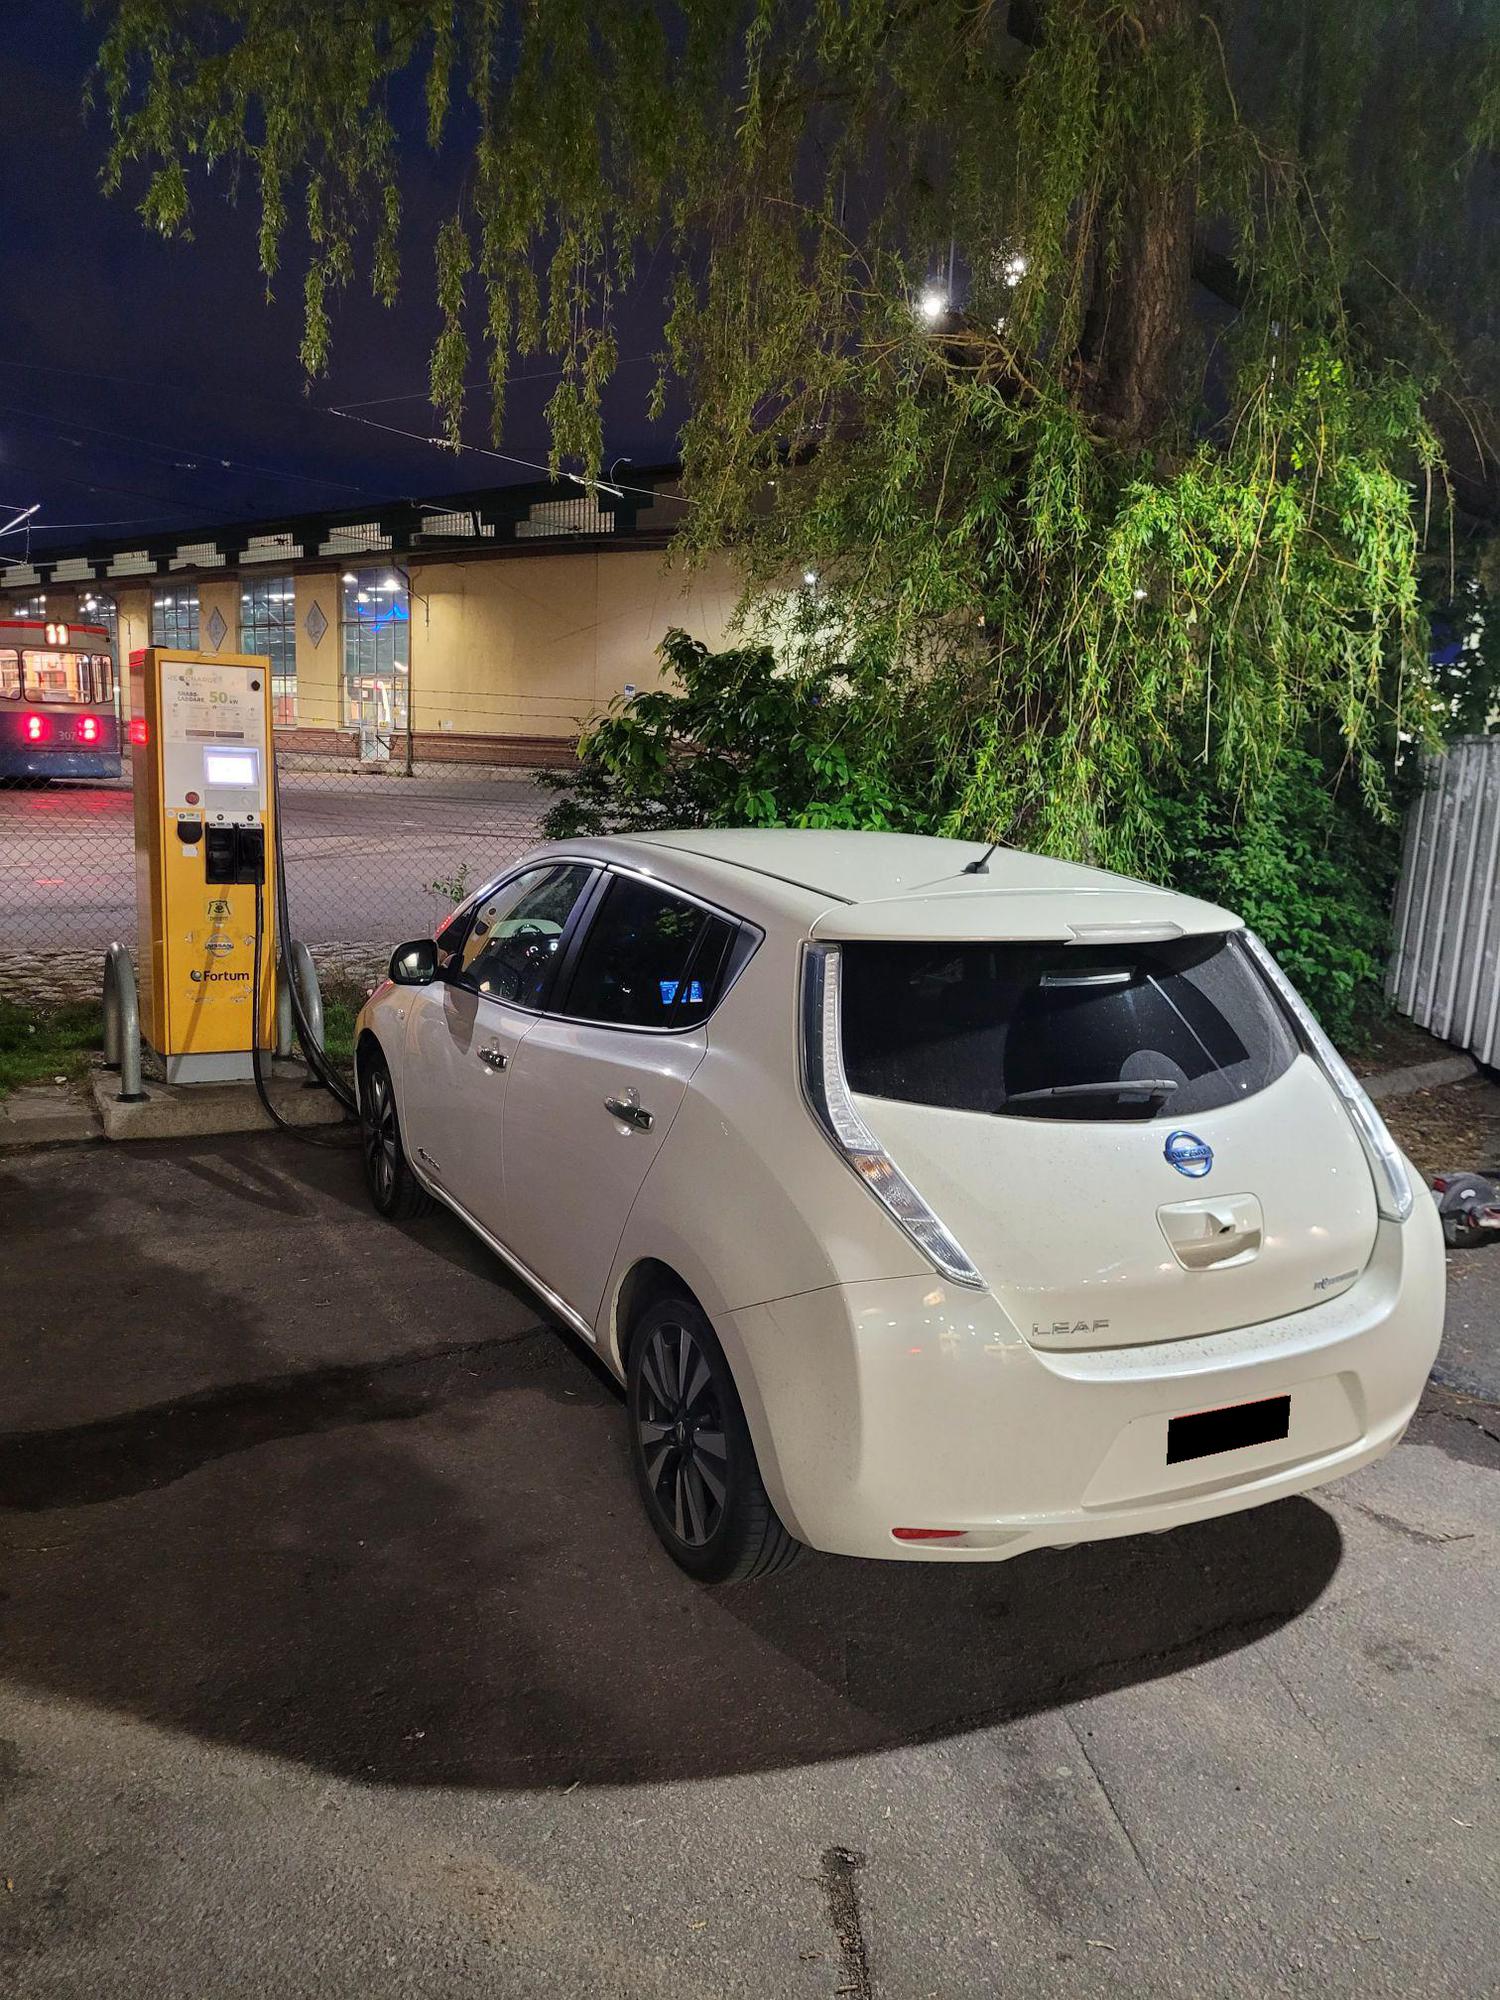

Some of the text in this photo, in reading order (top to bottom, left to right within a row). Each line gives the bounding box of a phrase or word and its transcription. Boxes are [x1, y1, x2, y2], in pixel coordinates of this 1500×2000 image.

[47, 624, 67, 645] 11
[209, 691, 228, 704] 50
[207, 942, 232, 950] NISSAN
[203, 969, 250, 981] Fortum
[1031, 1319, 1110, 1336] LEAF
